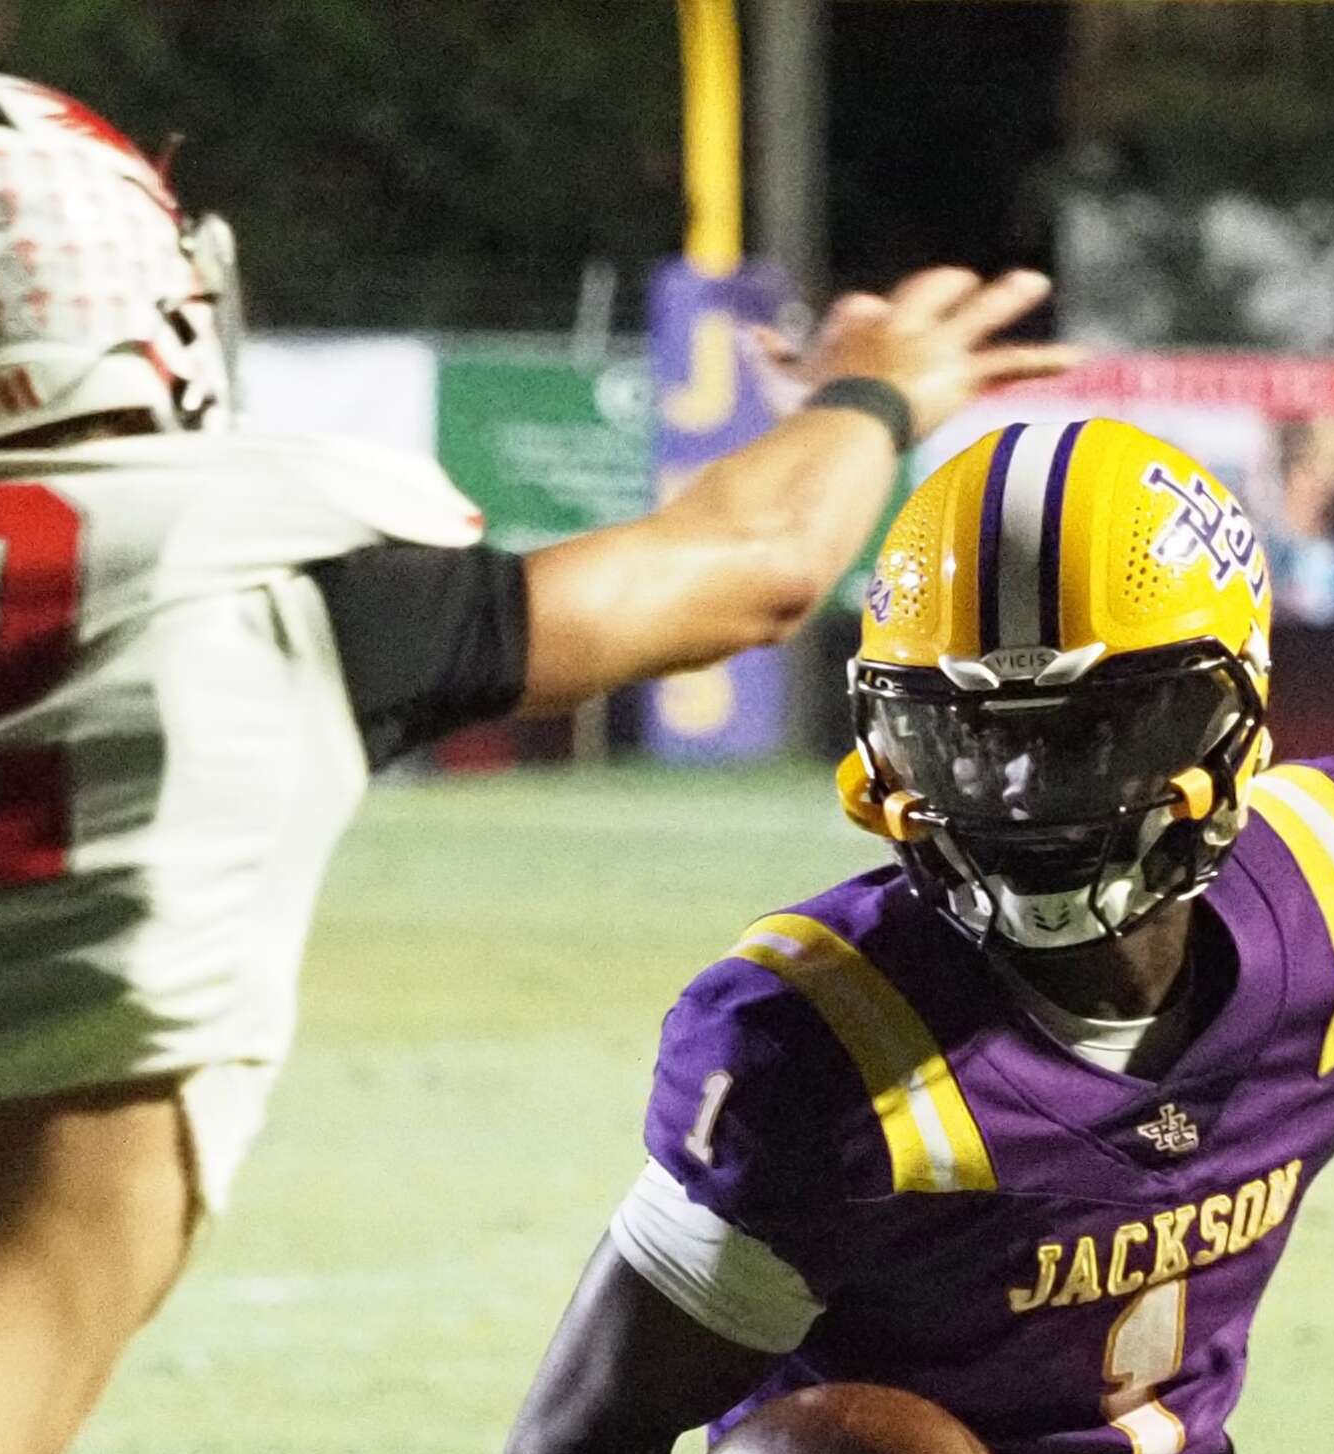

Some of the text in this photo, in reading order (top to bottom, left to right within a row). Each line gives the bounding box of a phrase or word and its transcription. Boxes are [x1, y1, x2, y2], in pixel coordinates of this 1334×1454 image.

[994, 653, 1049, 670] VICIS
[684, 1068, 734, 1168] 1
[1008, 1159, 1303, 1313] JACKSON
